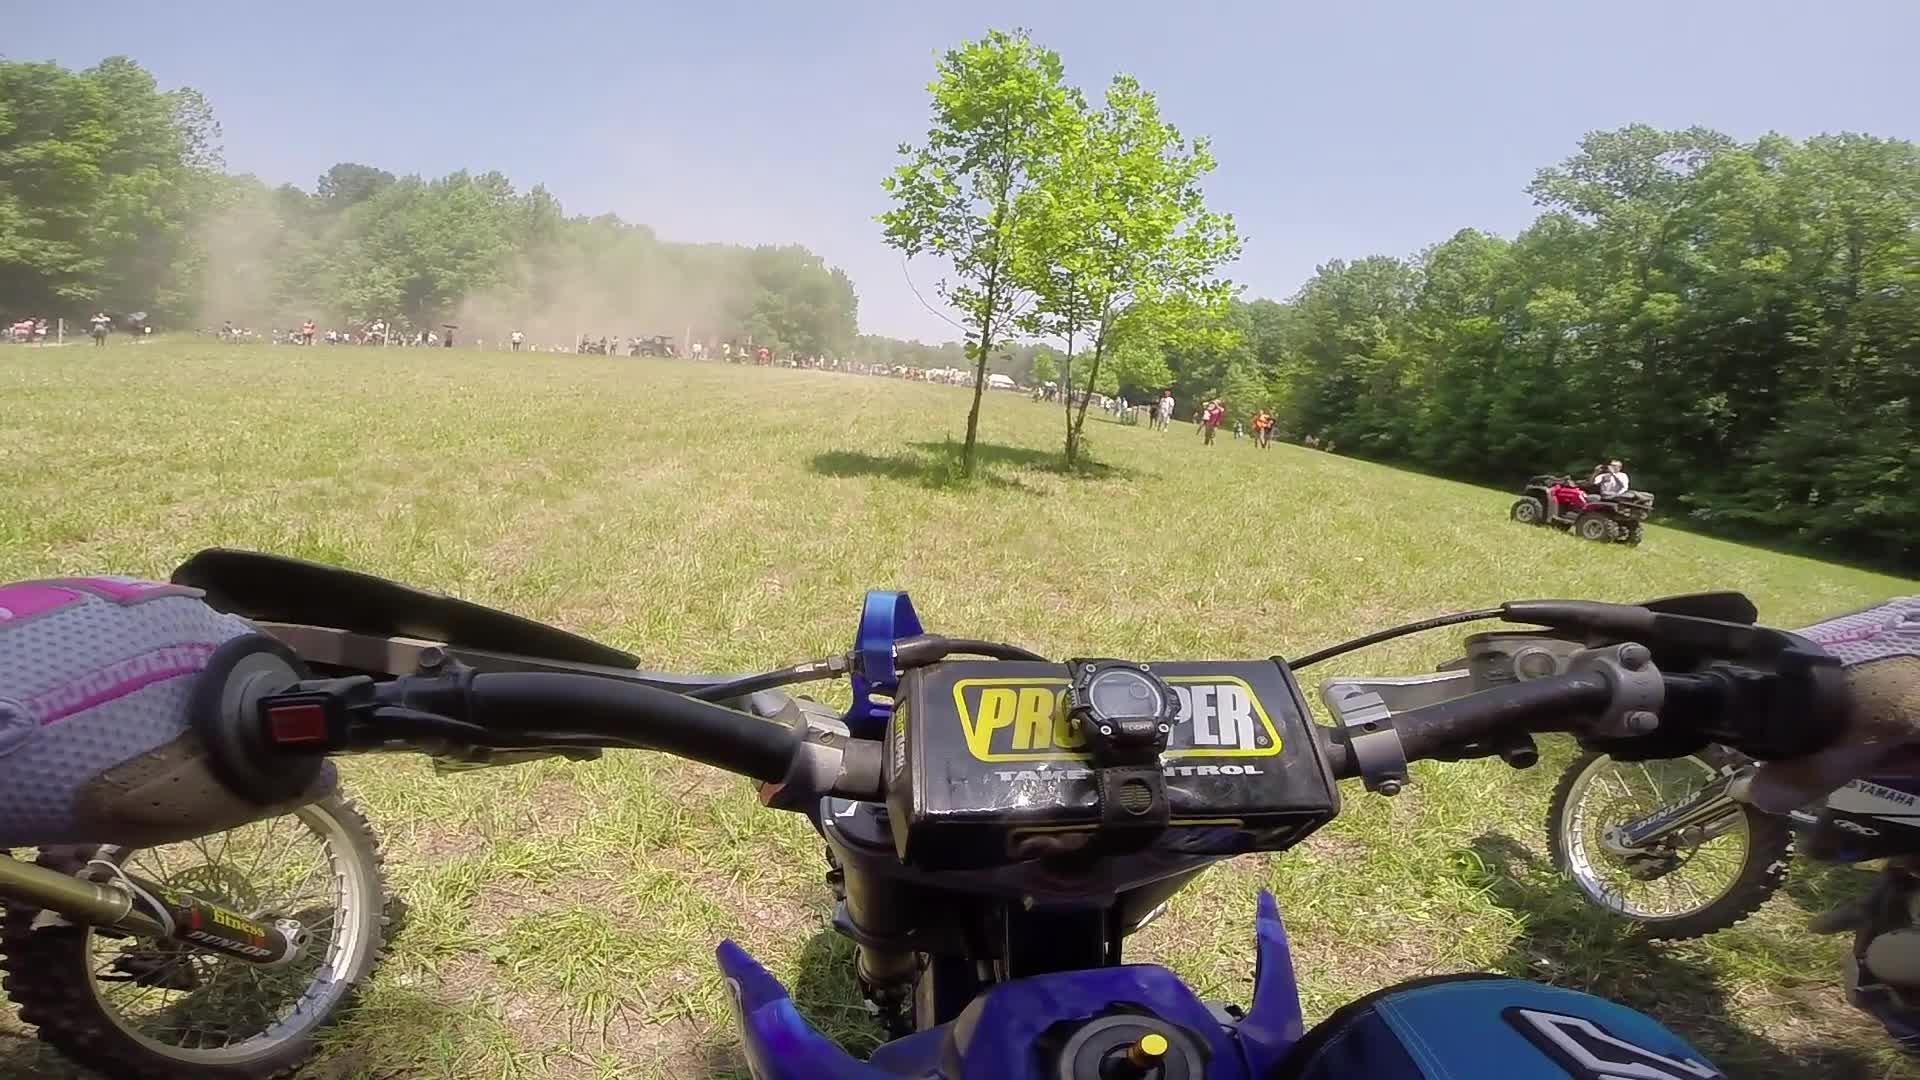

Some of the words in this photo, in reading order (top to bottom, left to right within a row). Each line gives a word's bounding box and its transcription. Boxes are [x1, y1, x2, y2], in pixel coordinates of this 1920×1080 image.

[977, 684, 1256, 752] PROPER
[1162, 764, 1265, 777] NTROL
[1859, 784, 1914, 807] YAMAHA
[187, 929, 273, 957] DUNLOP
